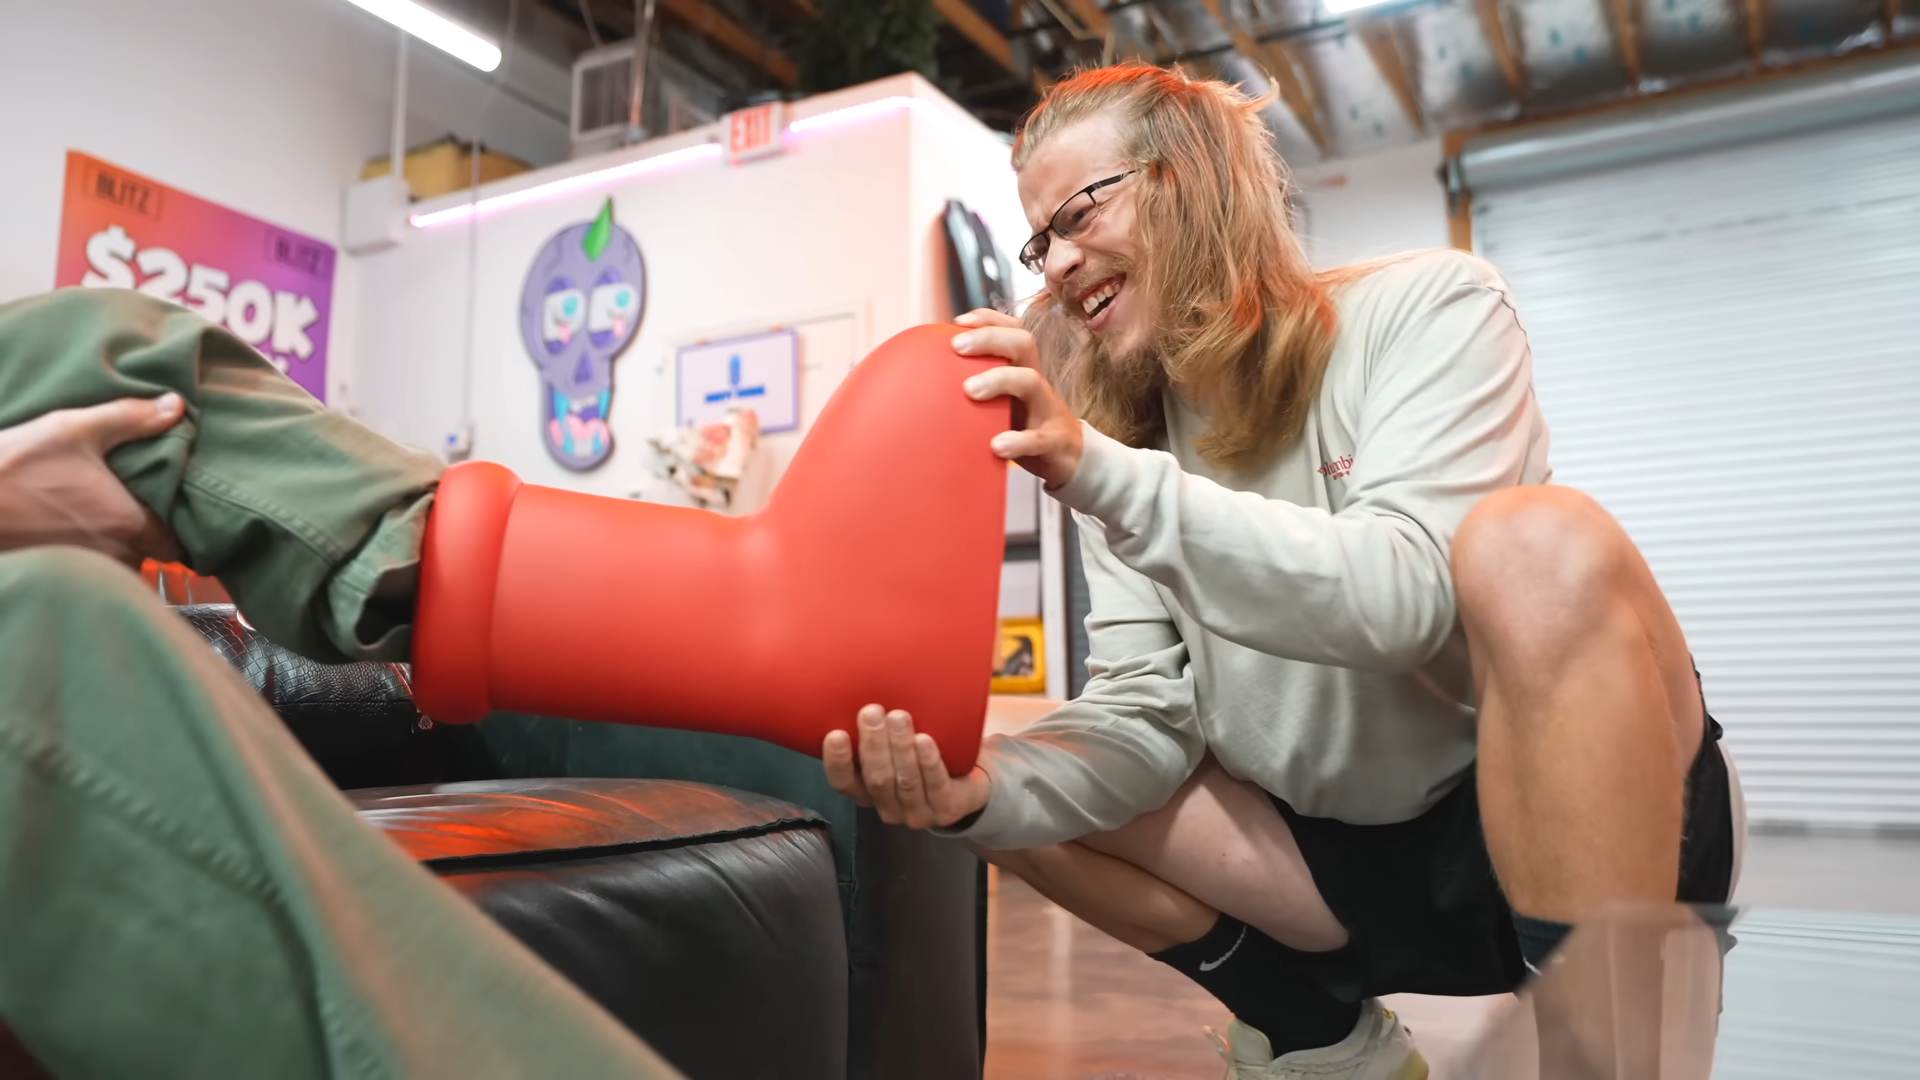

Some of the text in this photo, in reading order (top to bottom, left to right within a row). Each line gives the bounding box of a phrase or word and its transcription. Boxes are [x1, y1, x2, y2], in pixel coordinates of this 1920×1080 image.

[731, 104, 773, 154] EXIT
[94, 172, 152, 216] BLITZ
[80, 224, 319, 362] $250K
[1318, 454, 1353, 477] olumbi
